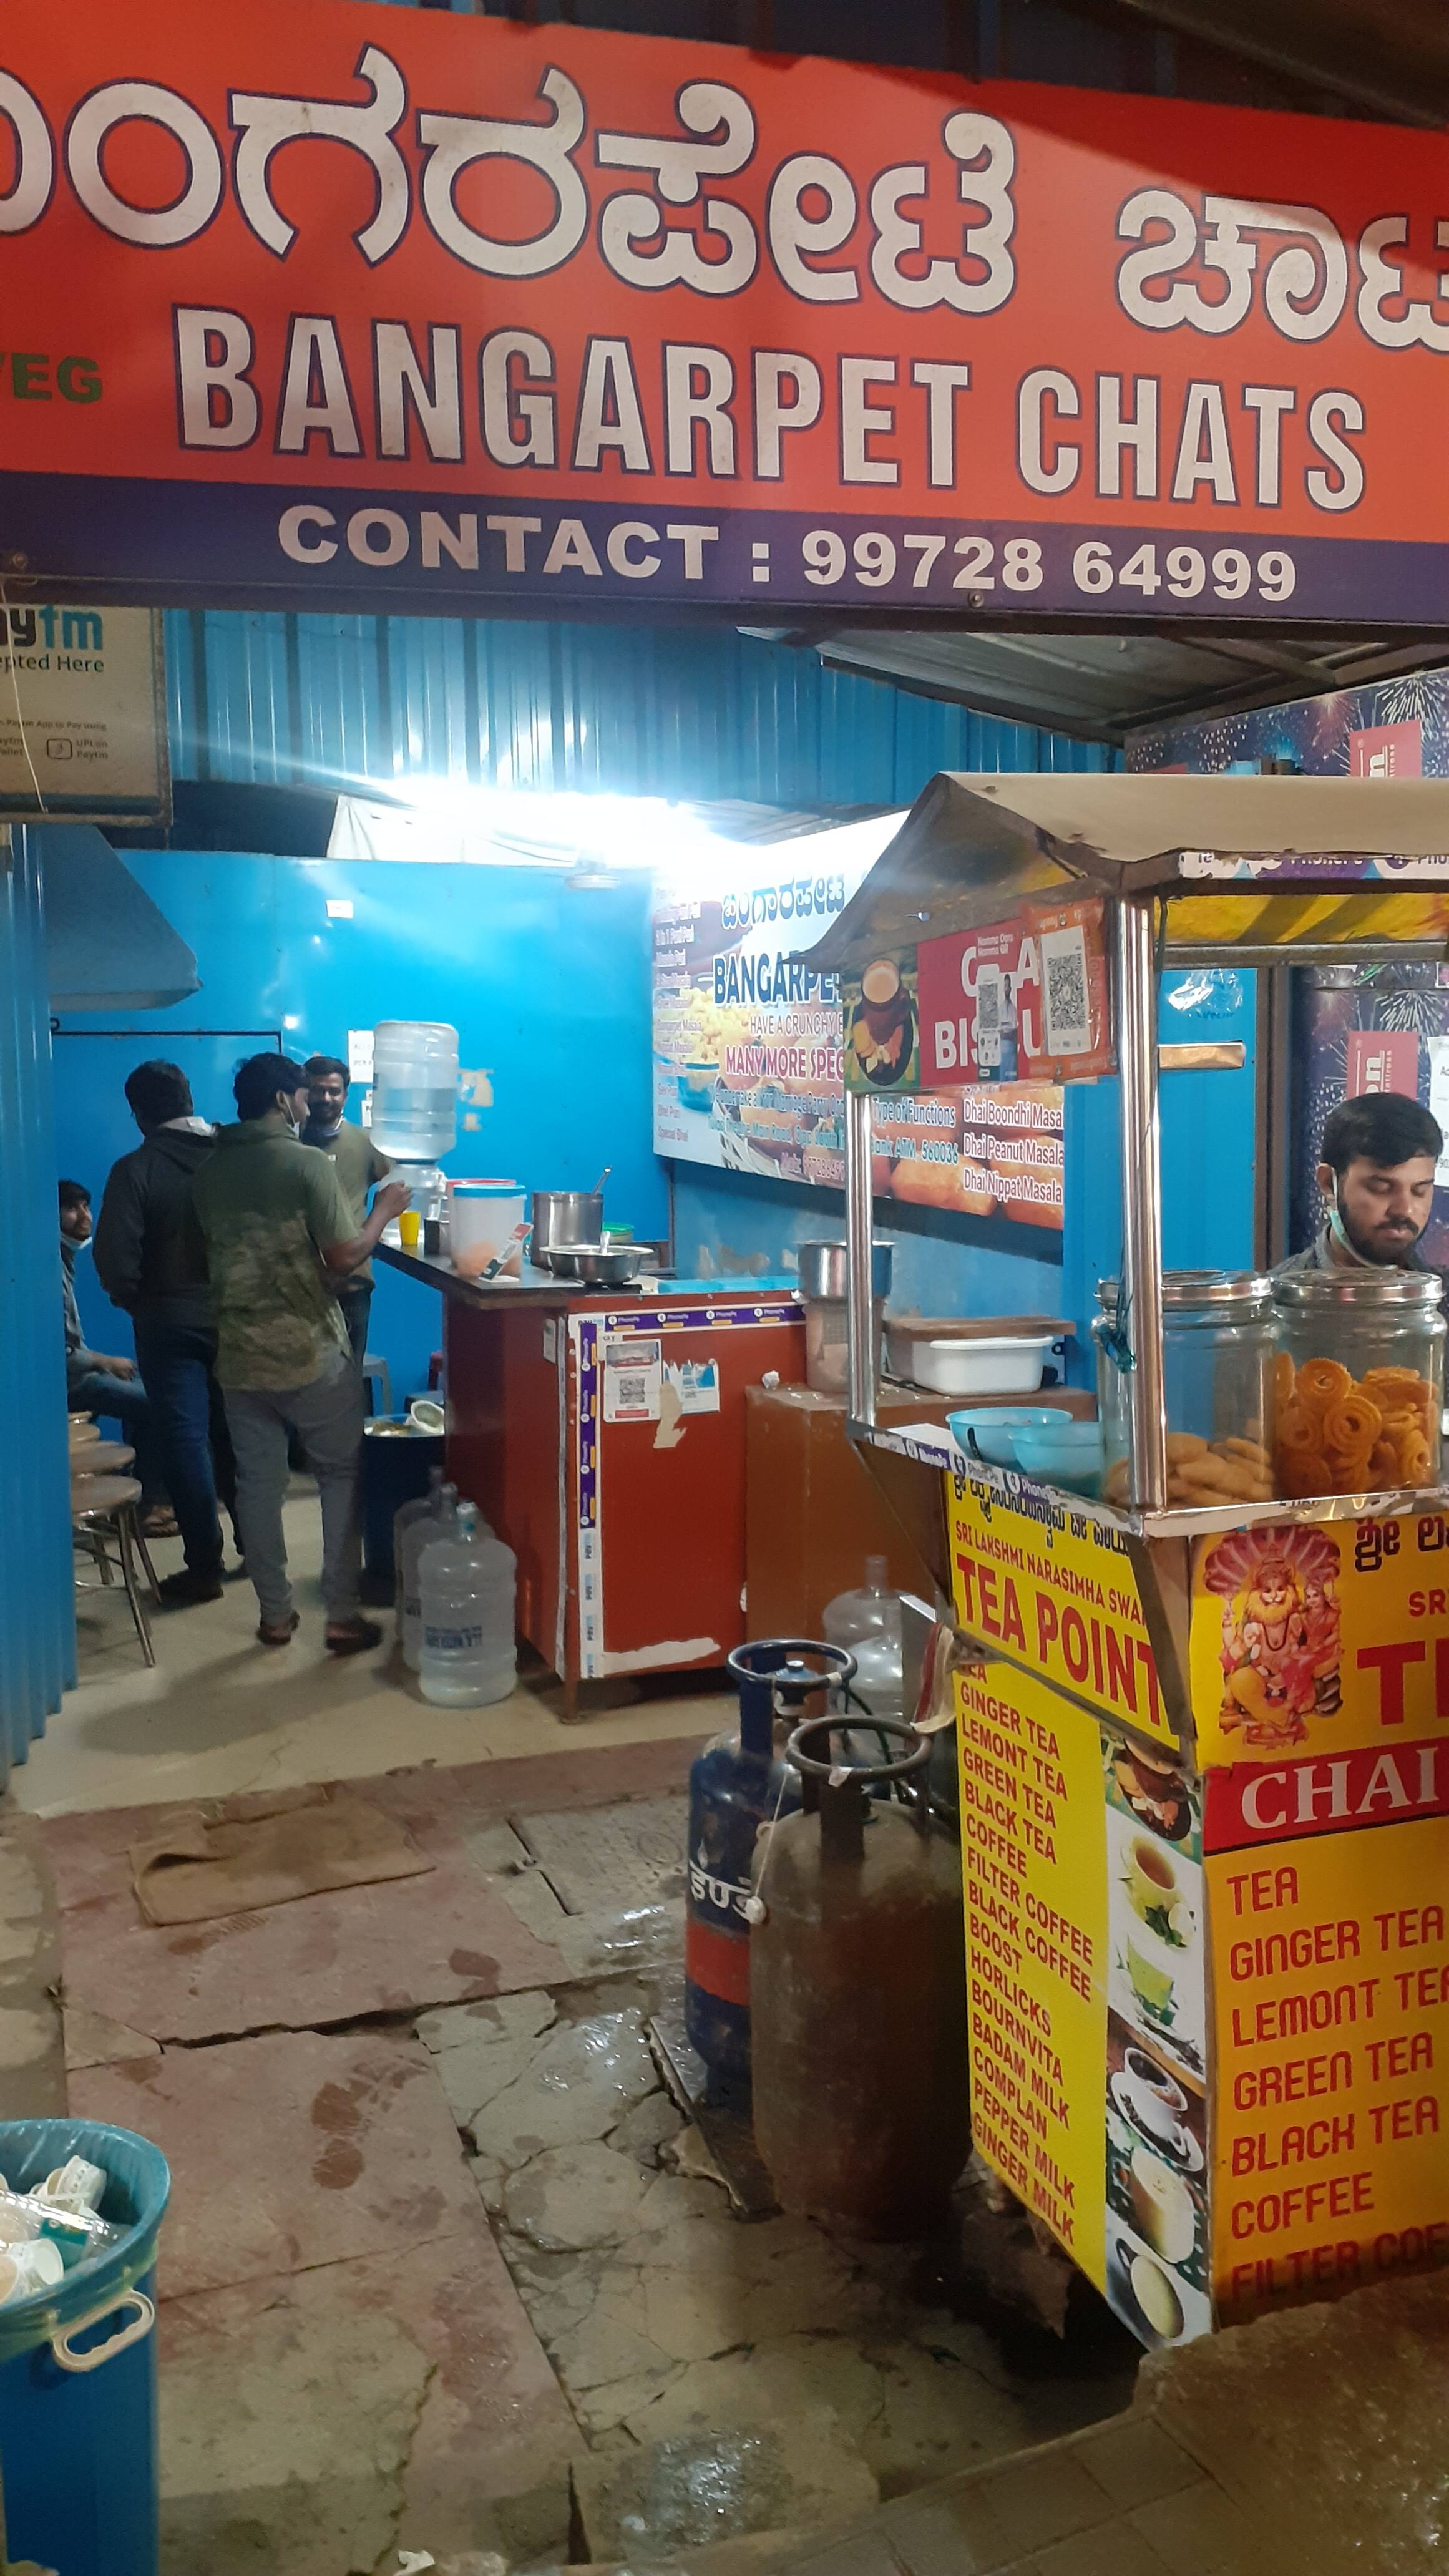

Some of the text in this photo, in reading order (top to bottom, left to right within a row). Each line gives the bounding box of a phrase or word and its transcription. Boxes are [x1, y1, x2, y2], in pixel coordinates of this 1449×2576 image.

[0, 353, 102, 404] EG
[172, 303, 1367, 513] BANGARPET CHATS
[278, 504, 1297, 602] CONTACT : 99728 64999
[0, 655, 104, 673] pted Here
[714, 950, 843, 1002] BANGARPE
[726, 1047, 763, 1076] MANY
[767, 1048, 806, 1078] MORE
[750, 1015, 774, 1035] HAVE
[786, 1014, 836, 1036] CRUNCHY
[873, 1138, 894, 1157] ank
[922, 1141, 959, 1164] 560036
[907, 1100, 956, 1128] Functions
[964, 1134, 987, 1159] Dhai
[988, 1137, 1023, 1164] Peanut
[965, 1099, 987, 1123] Dhai
[988, 1102, 1031, 1126] Boondhi
[964, 1170, 1062, 1204] Dhai Nippat Masala
[955, 1520, 1146, 1627] SRI LAKSHMI NARASIMHA SWA
[956, 1552, 1160, 1727] TEA POINT
[960, 1680, 1061, 1762] GINGER TEA
[962, 1713, 1068, 1802] LEMONT TEA
[963, 1747, 1057, 1830] GREEN TEA
[965, 1778, 1057, 1865] BLACK TEA
[1241, 1747, 1440, 1830] CHAI
[966, 1812, 1027, 1878] COFFEE
[967, 1845, 1093, 1968] FILTER COFFEE
[1227, 1866, 1299, 1915] TEA
[968, 1879, 1091, 2003] BLACK COFFEE
[969, 1911, 1023, 1975] BOOST
[1229, 1905, 1444, 1981] GINGER TEA
[970, 1945, 1051, 2037] HORLICKS
[1232, 1978, 1380, 2047] LEMONT
[971, 1978, 1064, 2088] BOURNVITA
[972, 2012, 1071, 2130] BADAM MILK
[1233, 2032, 1433, 2112] GREEN TEA
[973, 2046, 1047, 2140] COMPLAN
[1368, 2095, 1439, 2144] TEA
[974, 2076, 1075, 2210] PEPPER MILK
[974, 2111, 1074, 2246] GINGER MILK
[1231, 2171, 1375, 2240] COFFEE
[1232, 2240, 1360, 2303] FILTER
